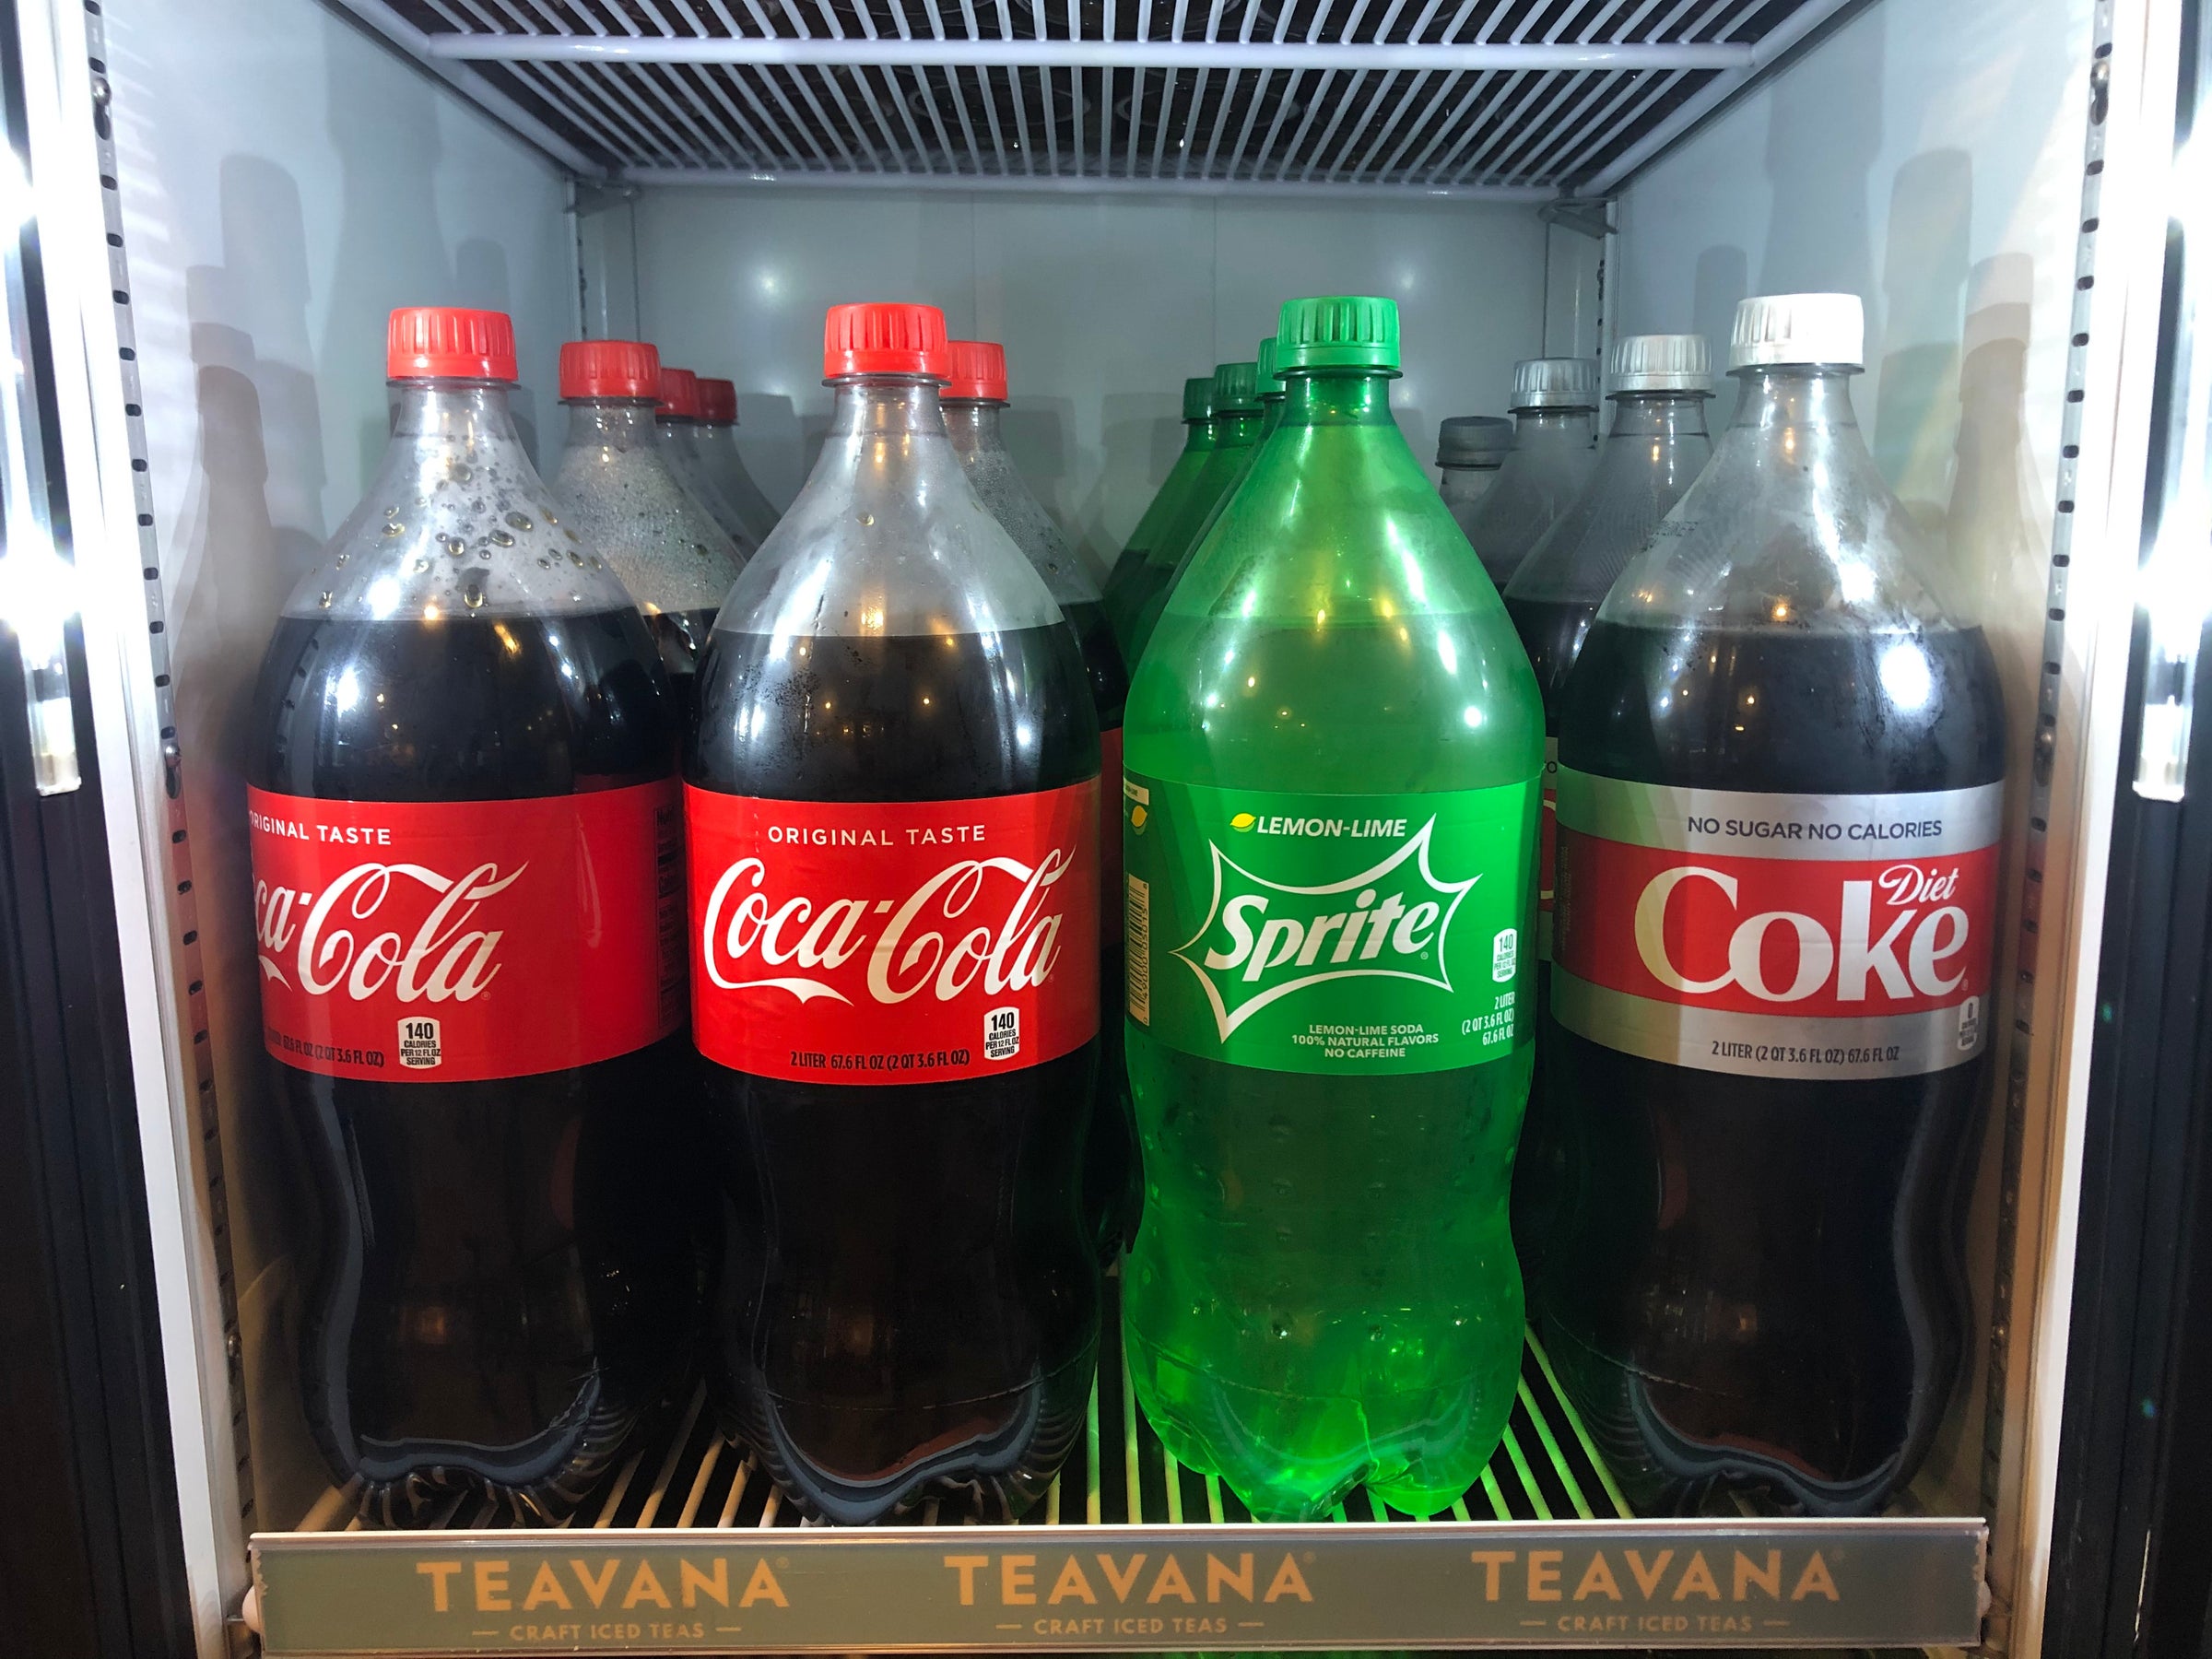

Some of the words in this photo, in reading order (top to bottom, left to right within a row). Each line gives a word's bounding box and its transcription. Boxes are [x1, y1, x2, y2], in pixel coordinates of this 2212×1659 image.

[316, 824, 392, 845] TASTE
[768, 826, 894, 846] ORIGINAL
[905, 825, 986, 845] TASTE
[1256, 816, 1407, 838] LEMON-LIME
[1688, 817, 1720, 835] NO
[1725, 819, 1803, 840] SUGAR
[1808, 823, 1842, 841] NO
[1848, 820, 1942, 841] CALORIES
[1878, 864, 1959, 906] Diet
[254, 861, 529, 1003] ca-Cola
[703, 844, 1077, 1006] Coca-Cola
[1204, 888, 1440, 982] Sprite
[1635, 865, 1970, 1002] Coke
[1500, 934, 1513, 952] 140
[1494, 996, 1499, 1009] 2
[1500, 991, 1515, 1007] LITER
[406, 1022, 434, 1039] 140
[991, 1011, 1015, 1031] 140
[1309, 1024, 1388, 1036] LEMON-LIME
[1390, 1024, 1424, 1035] SODA
[1462, 1019, 1471, 1035] (2
[1472, 1017, 1483, 1031] QT
[1484, 1013, 1495, 1030] 3.6
[1496, 1011, 1503, 1026] FL
[404, 1040, 437, 1048] CALORIES
[989, 1029, 1017, 1041] CALORIES
[1292, 1034, 1325, 1046] 100%
[1327, 1037, 1385, 1047] NATURAL
[1387, 1033, 1439, 1046] FLAVORS
[1482, 1029, 1498, 1045] 67.6
[1499, 1026, 1505, 1041] FL
[1506, 1023, 1513, 1038] OZ
[986, 1041, 997, 1050] PER
[991, 1046, 1015, 1057] SERVING
[1324, 1048, 1345, 1058] NO
[1347, 1047, 1406, 1058] CAFFEINE
[1712, 1041, 1720, 1056] 2
[1722, 1042, 1752, 1059] LITER
[1756, 1044, 1768, 1062] (2
[1771, 1046, 1785, 1061] QT
[1788, 1046, 1806, 1063] 3.6
[1809, 1047, 1821, 1063] FL
[1825, 1047, 1844, 1065] OZ)
[1848, 1047, 1870, 1062] 67.6
[1874, 1046, 1883, 1061] FL
[1887, 1046, 1900, 1061] OZ
[337, 1048, 351, 1064] 3.6
[353, 1050, 364, 1065] FL
[366, 1051, 384, 1067] OZ)
[406, 1056, 436, 1065] SERVING
[790, 1051, 798, 1066] 2
[799, 1053, 826, 1068] LITER
[830, 1054, 853, 1069] 67.6
[855, 1055, 866, 1070] FL
[870, 1054, 884, 1070] OZ
[887, 1054, 899, 1071] (2
[901, 1053, 913, 1069] QT
[918, 1052, 935, 1067] 3.6
[936, 1051, 949, 1066] FL
[951, 1049, 971, 1065] OZ)
[416, 1558, 790, 1612] TEAVANA
[943, 1552, 1313, 1606] TEAVANA
[1471, 1549, 1841, 1602] TEAVANA
[509, 1624, 581, 1641] CRAFT
[590, 1623, 641, 1641] ICED
[648, 1622, 705, 1639] TEAS
[1033, 1618, 1103, 1635] CRAFT
[1113, 1618, 1163, 1635] ICED
[1171, 1618, 1228, 1634] TEAS
[1557, 1615, 1629, 1632] CRAFT
[1637, 1616, 1688, 1632] ICED
[1697, 1616, 1753, 1633] TEAS
